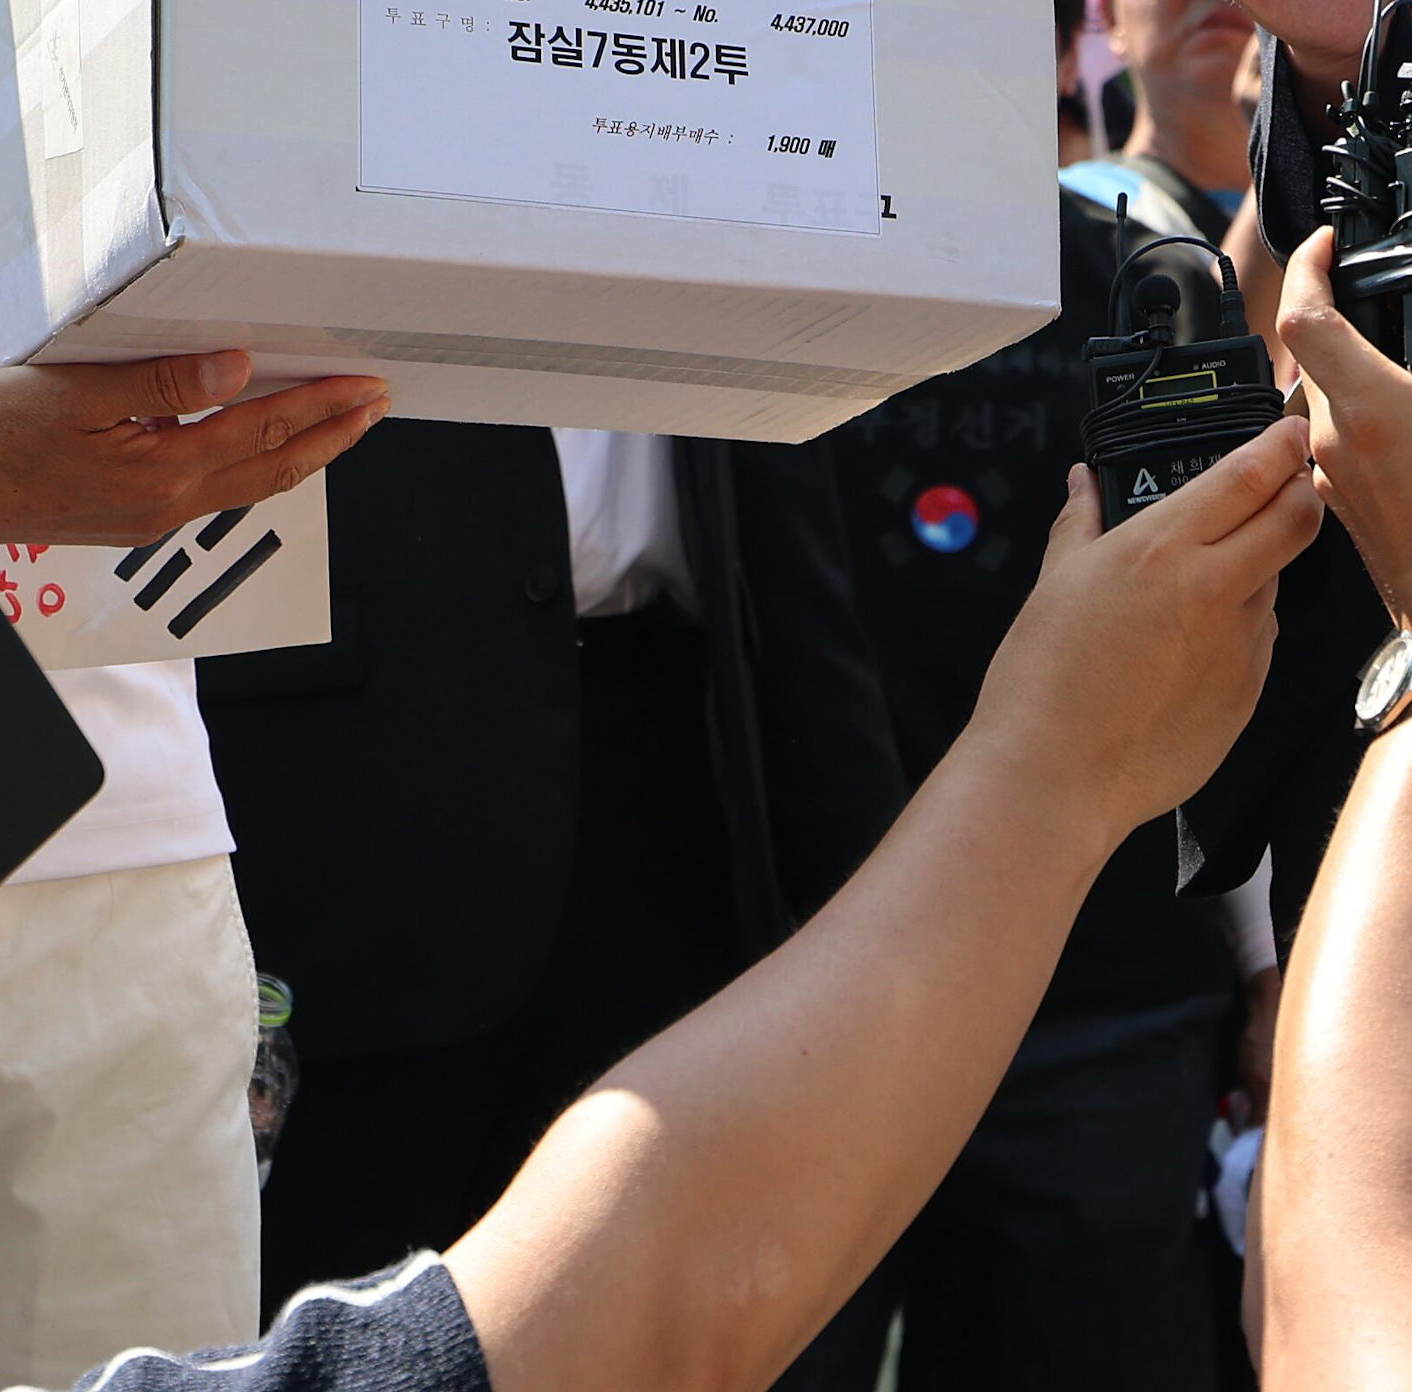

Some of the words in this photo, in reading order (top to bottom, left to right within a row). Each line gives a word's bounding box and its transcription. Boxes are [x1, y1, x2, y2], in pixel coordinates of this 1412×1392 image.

[692, 5, 719, 24] No.
[770, 13, 850, 38] 4,437,000
[507, 20, 749, 86] 잠실7동제2투
[592, 116, 720, 145] 투표용지배부매수
[766, 134, 810, 156] 1,900
[818, 139, 837, 159] 매
[1105, 373, 1135, 384] POWER
[1201, 360, 1227, 370] AUDIO
